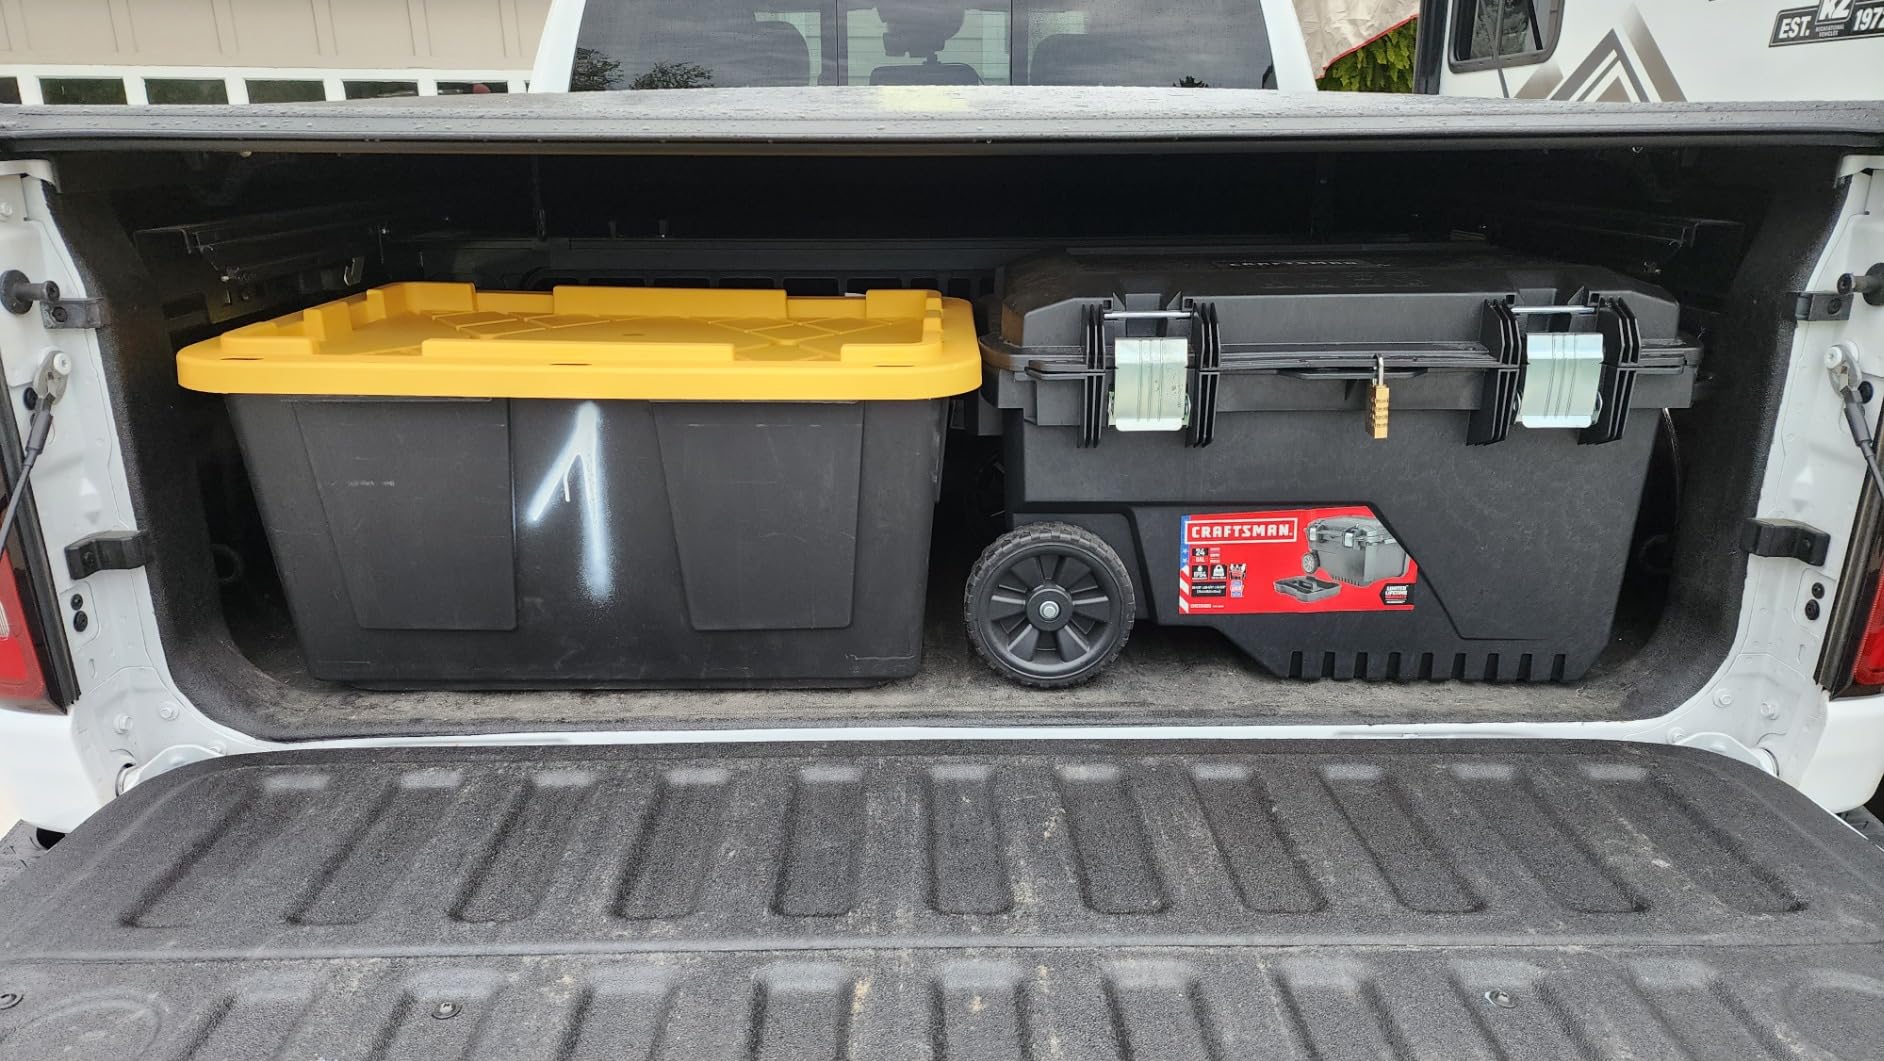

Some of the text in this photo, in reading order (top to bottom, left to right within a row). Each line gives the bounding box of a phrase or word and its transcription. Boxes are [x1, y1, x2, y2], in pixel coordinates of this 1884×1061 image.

[1778, 16, 1811, 38] EST.
[526, 401, 614, 602] 1
[1195, 548, 1205, 556] 24
